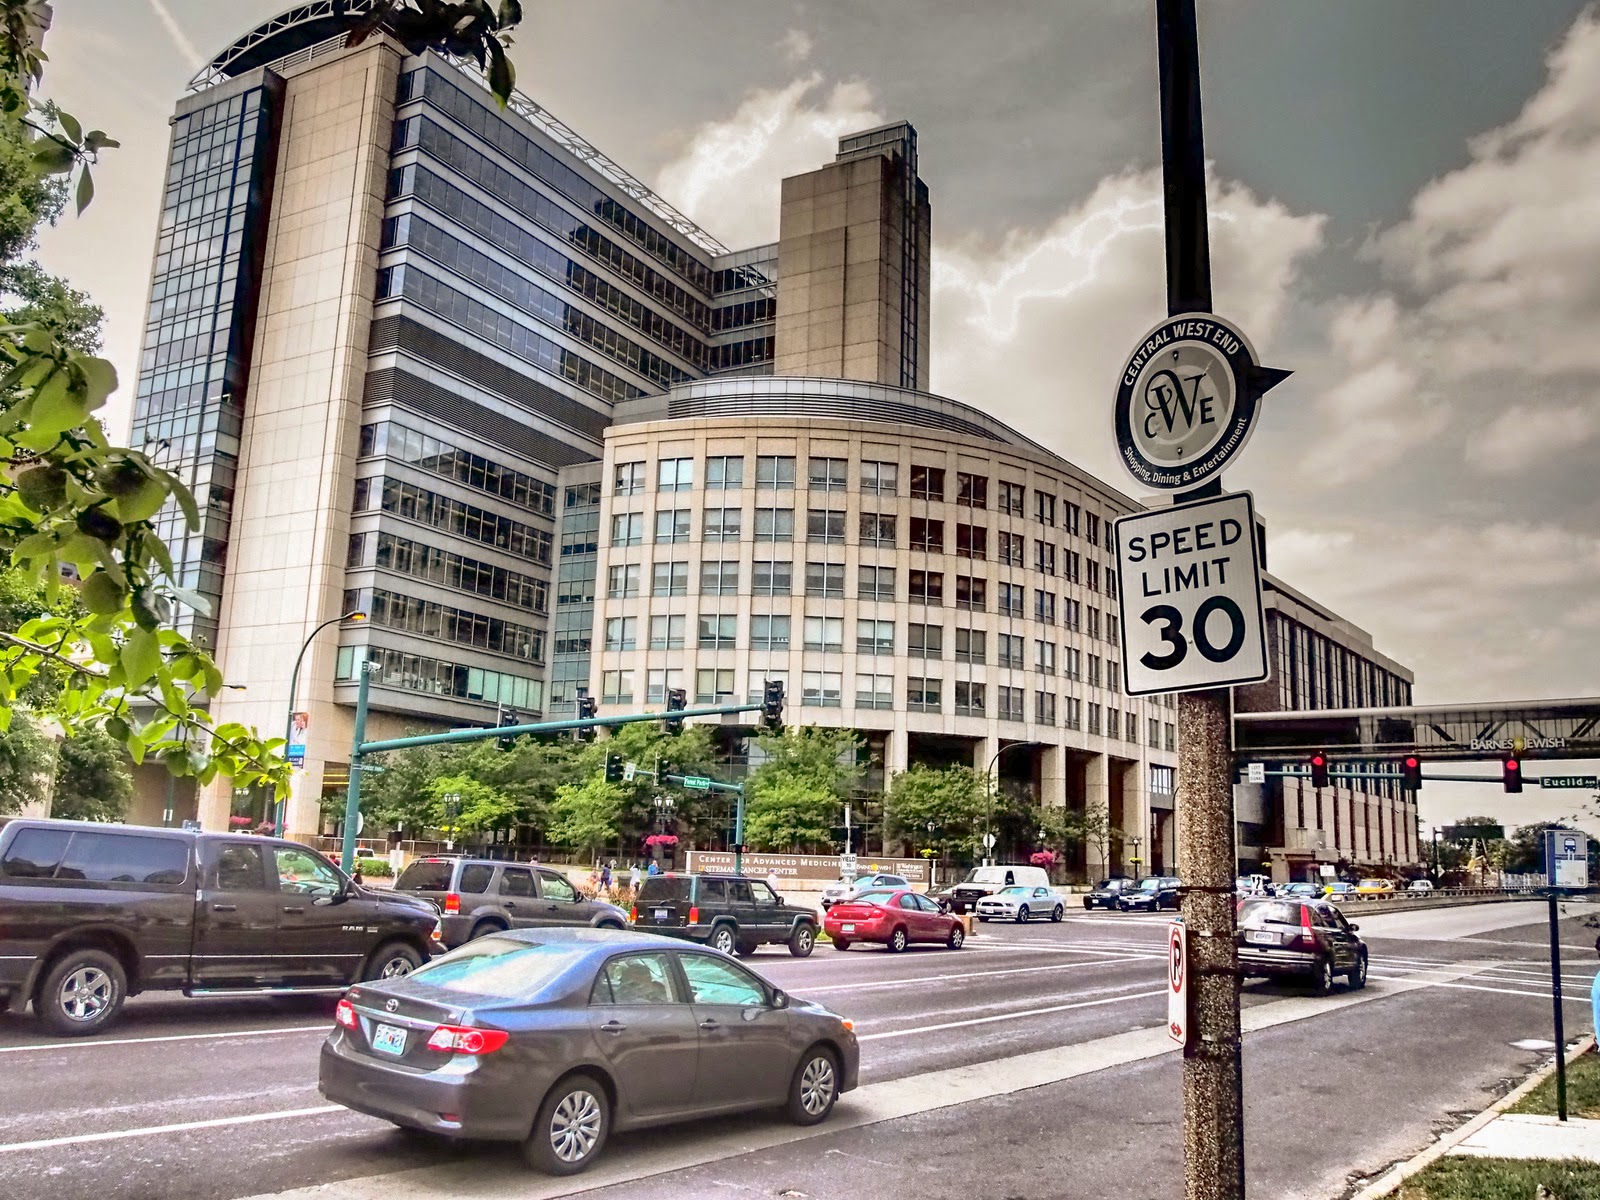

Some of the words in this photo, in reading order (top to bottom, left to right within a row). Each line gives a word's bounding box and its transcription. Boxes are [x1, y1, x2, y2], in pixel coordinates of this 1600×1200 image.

[1124, 330, 1170, 386] CENTRAL
[1173, 322, 1213, 338] WEST
[1212, 330, 1239, 355] END
[1124, 446, 1152, 482] Shopping,
[1152, 473, 1181, 485] Dining
[1183, 471, 1191, 481] &
[1193, 417, 1247, 477] Entertainment
[1128, 518, 1242, 562] SPEED
[1142, 557, 1230, 597] LIMIT
[1139, 595, 1246, 671] 30
[1470, 738, 1514, 750] BARNES
[1523, 737, 1565, 750] JEWISH
[1543, 778, 1583, 786] Euclid
[699, 855, 731, 863] CENTER
[753, 857, 797, 866] ADVANCED
[704, 865, 736, 873] SITEMAN
